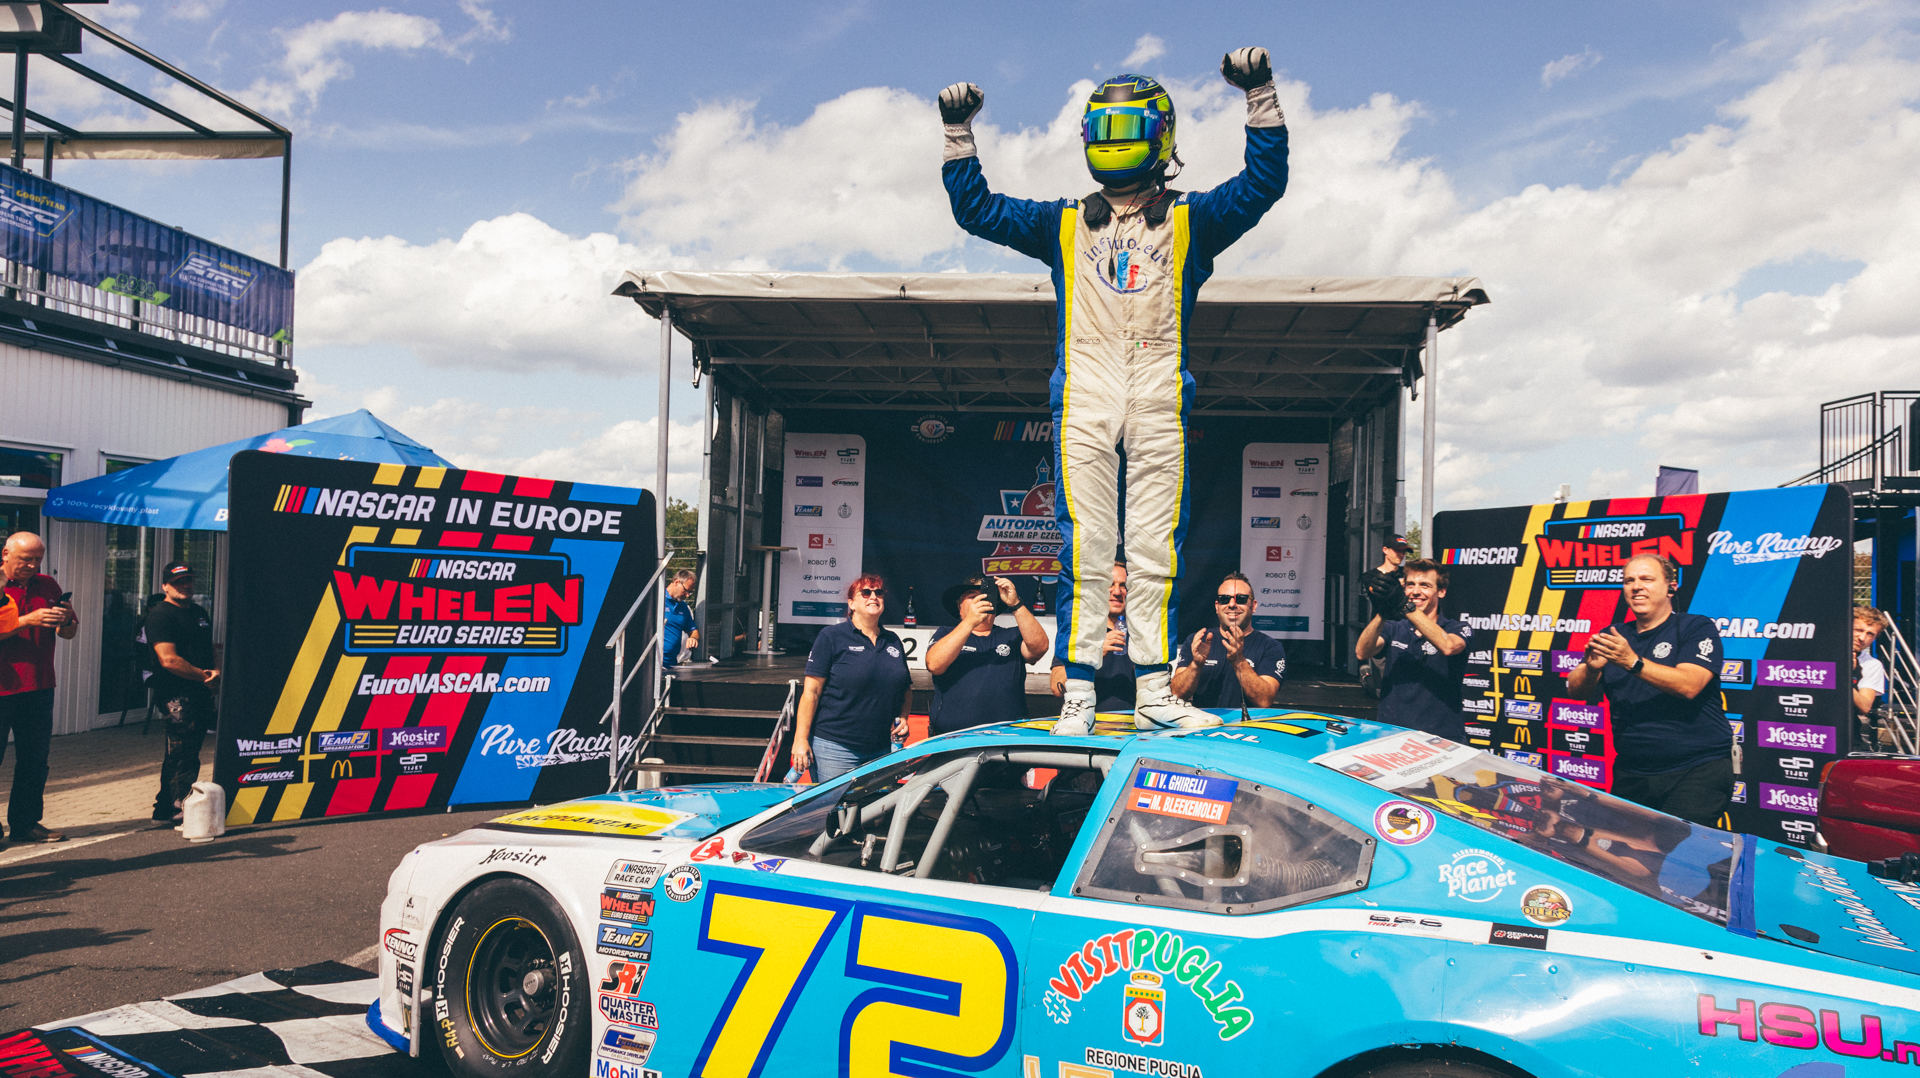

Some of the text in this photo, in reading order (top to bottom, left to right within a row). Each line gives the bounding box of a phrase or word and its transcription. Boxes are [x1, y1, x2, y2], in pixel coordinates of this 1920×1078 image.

[16, 190, 66, 211] GOODYEAR
[219, 262, 251, 277] GOODYEAR
[140, 507, 159, 515] plast
[314, 487, 622, 535] NASCAR IN EUROPE
[985, 518, 1058, 530] AUTODRO
[1594, 523, 1646, 538] NASCAR
[1040, 532, 1062, 540] CZEC
[1707, 531, 1843, 559] Pure Racing
[1459, 547, 1518, 564] NASCAR
[435, 559, 516, 581] NASCAR
[1575, 569, 1606, 582] EURO
[333, 570, 580, 624] WHELEN
[1460, 613, 1592, 634] EuroNASCAR.com
[396, 625, 525, 645] EURO SERIES
[902, 638, 918, 661] 2
[1720, 662, 1742, 674] FJ
[1764, 664, 1827, 681] Hoosier
[357, 672, 551, 695] EuroNASCAR.com
[1556, 707, 1599, 722] Hoosier
[236, 736, 302, 752] WHELEN
[388, 729, 441, 747] Hoosier
[480, 724, 541, 756] Pure
[1766, 727, 1827, 744] Hoosier
[1352, 738, 1440, 771] WHELEN
[240, 770, 295, 782] KENNOL
[1557, 760, 1600, 776] Hoosier
[1159, 773, 1208, 795] V. GHIRELLI
[1150, 794, 1224, 820] M. BLEEKEMOLEN
[479, 848, 547, 867] Hoosier
[626, 863, 657, 875] NASCAR
[1438, 860, 1488, 882] Race
[613, 874, 651, 884] RACE CAR
[1448, 870, 1517, 897] Planet
[600, 893, 656, 916] WHELEN
[621, 892, 641, 901] NASCAR
[611, 910, 639, 922] EURO SERIES
[437, 916, 465, 999] HOOSIER
[598, 946, 649, 960] MOTORSPORTS
[601, 962, 647, 995] SRI
[690, 880, 1019, 1078] 72
[1043, 928, 1254, 1041] #VISITPUGLIA
[601, 996, 654, 1015] QUARTER
[541, 976, 570, 1065] HOOSIER
[609, 1010, 656, 1027] MASTER
[1087, 1049, 1201, 1078] REGIONE PUGLIA
